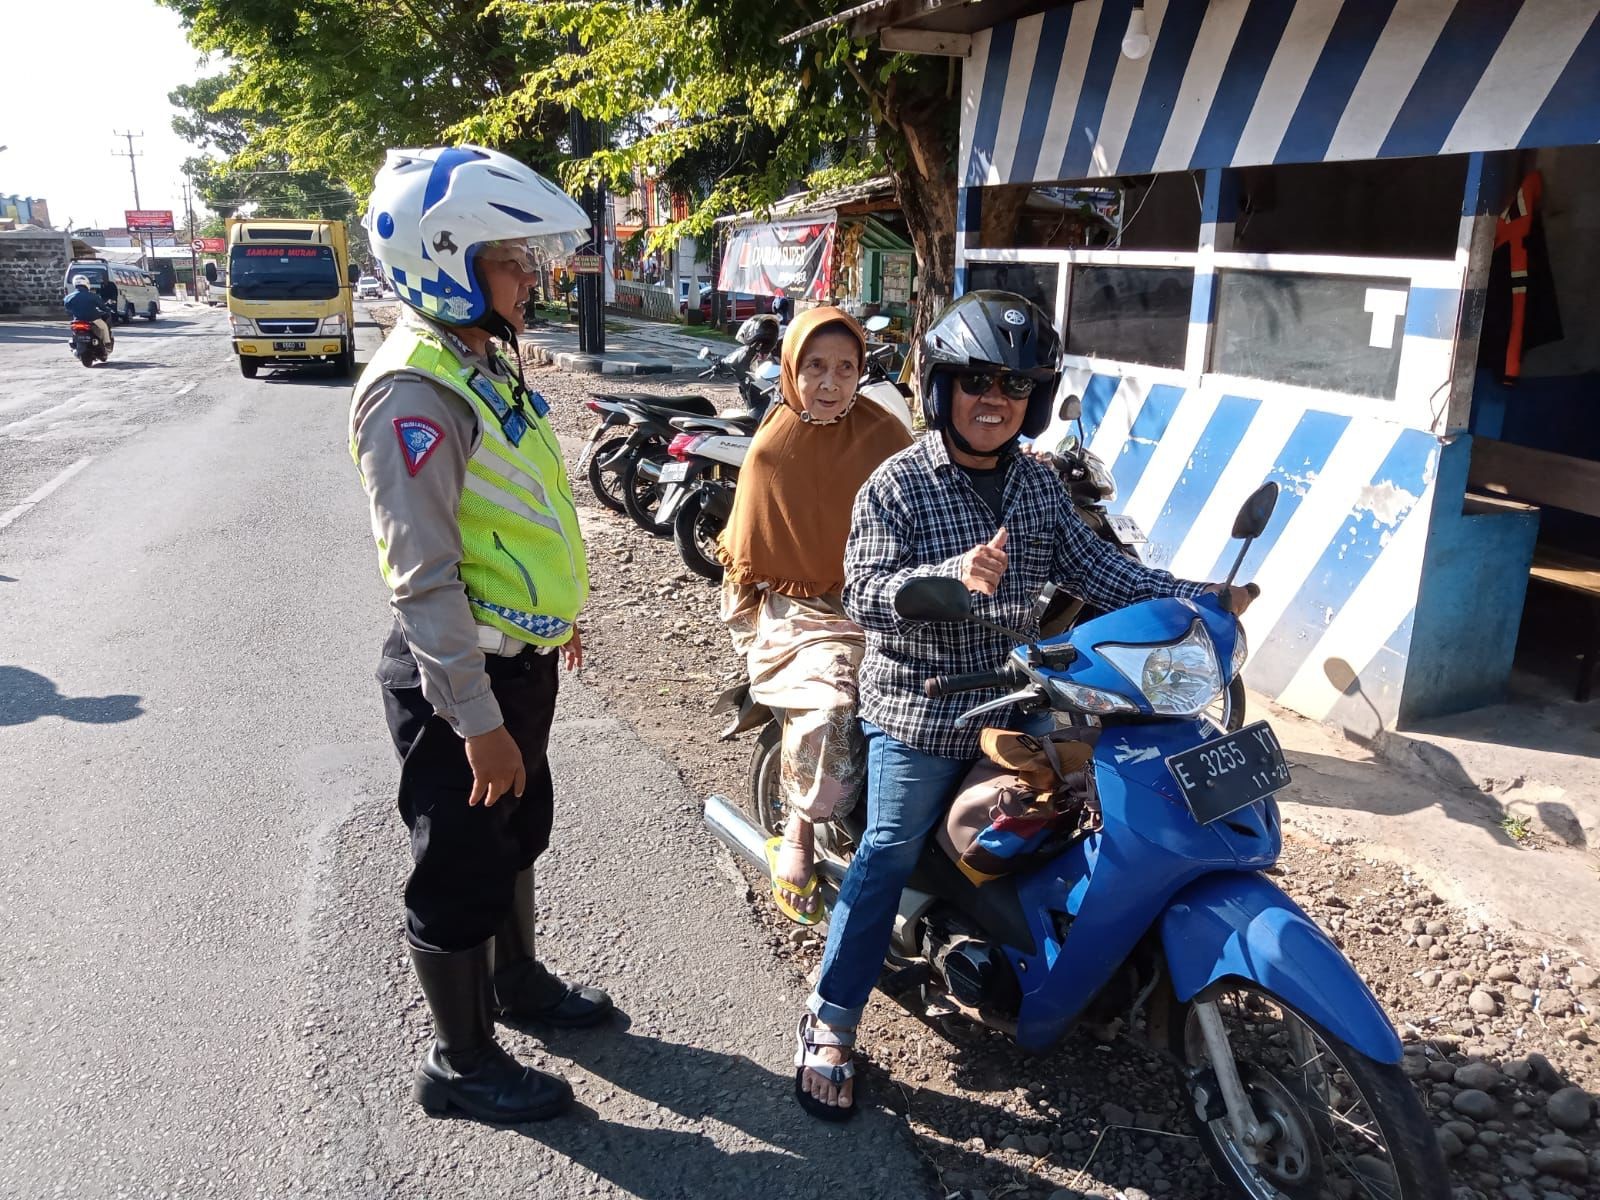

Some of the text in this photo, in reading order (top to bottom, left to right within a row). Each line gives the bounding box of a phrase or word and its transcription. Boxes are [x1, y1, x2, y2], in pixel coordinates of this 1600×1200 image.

[287, 248, 318, 257] MURAH
[1175, 727, 1279, 789] E 3255 YT
